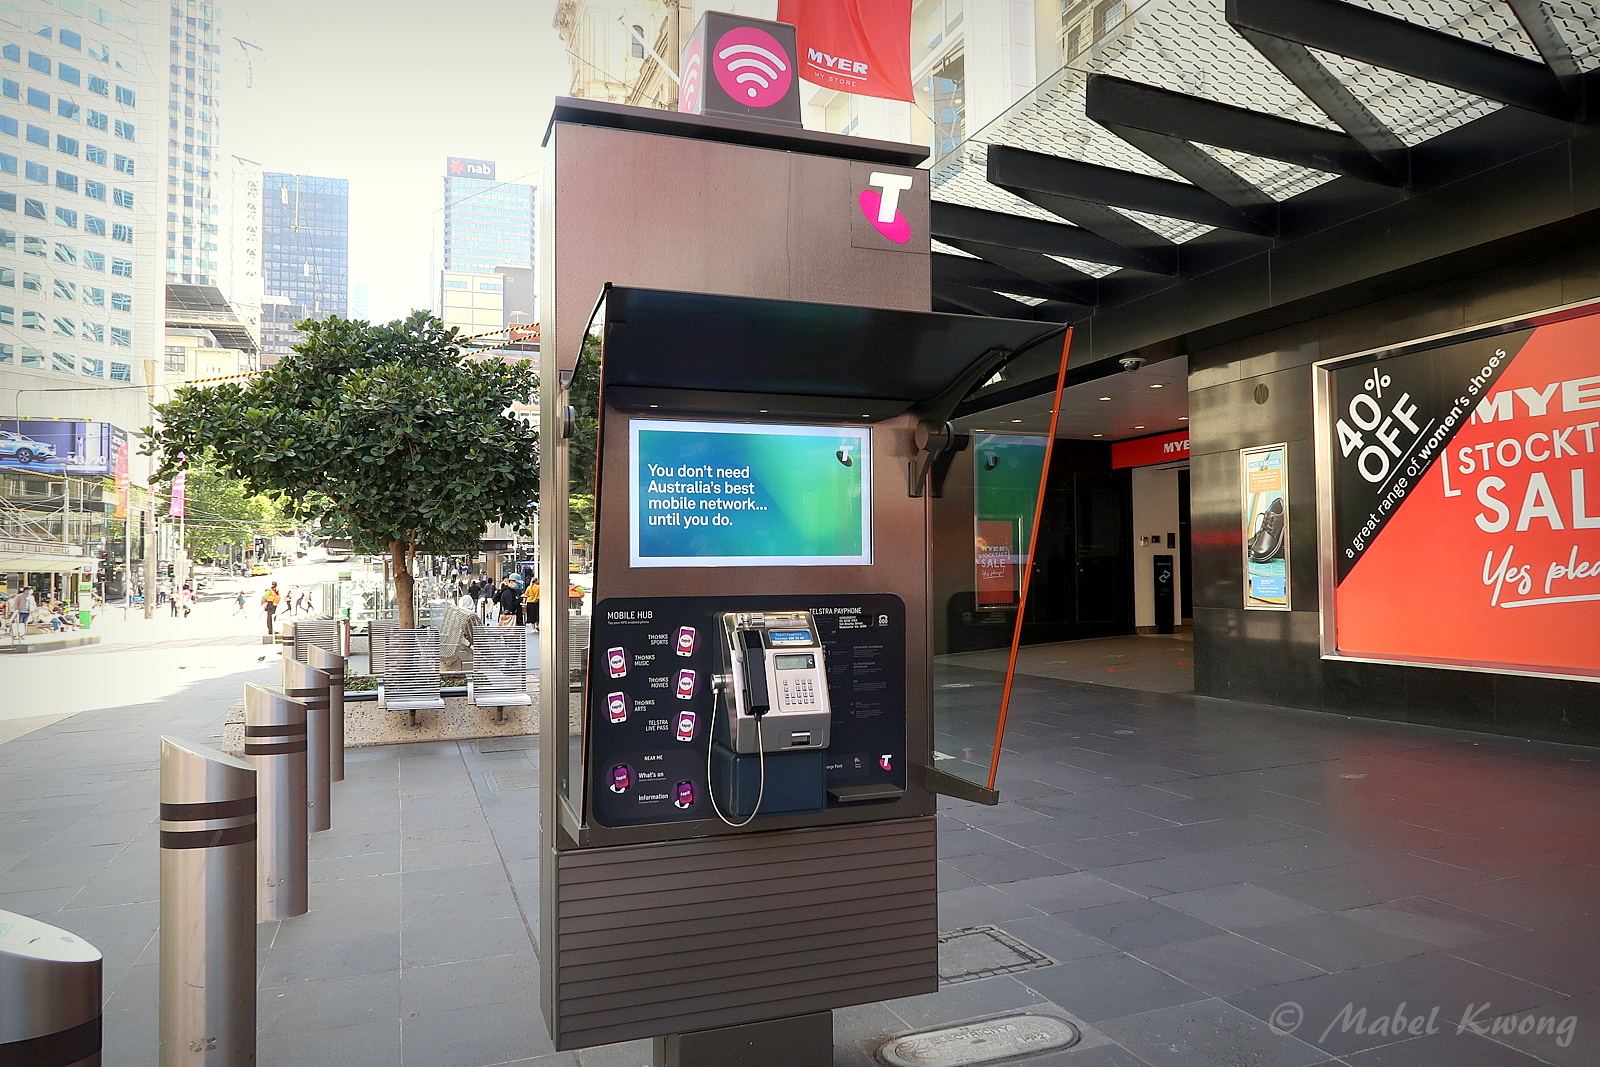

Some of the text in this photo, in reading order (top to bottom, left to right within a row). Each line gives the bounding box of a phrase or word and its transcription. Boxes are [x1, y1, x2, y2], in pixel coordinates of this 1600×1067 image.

[807, 48, 868, 75] MYER
[814, 72, 857, 87] MY STORE
[467, 163, 492, 175] nab
[1336, 367, 1391, 458] 40%
[1357, 392, 1421, 484] OFF
[1163, 440, 1190, 453] MYE
[1346, 548, 1355, 559] a
[1353, 513, 1380, 551] great
[1378, 478, 1408, 516] range
[1407, 457, 1421, 477] of
[1418, 394, 1470, 461] women's
[1468, 348, 1507, 396] shoes
[1458, 421, 1600, 475] STOCKT
[648, 463, 750, 479] You don't need
[648, 480, 755, 495] Australia's best
[648, 497, 768, 511] mobile network...
[1473, 468, 1600, 533] SAL
[648, 513, 733, 529] until you do.
[981, 559, 1006, 568] SALE
[1482, 545, 1532, 607] Yes
[607, 610, 653, 620] MOBILE HUB
[638, 793, 669, 801] Information
